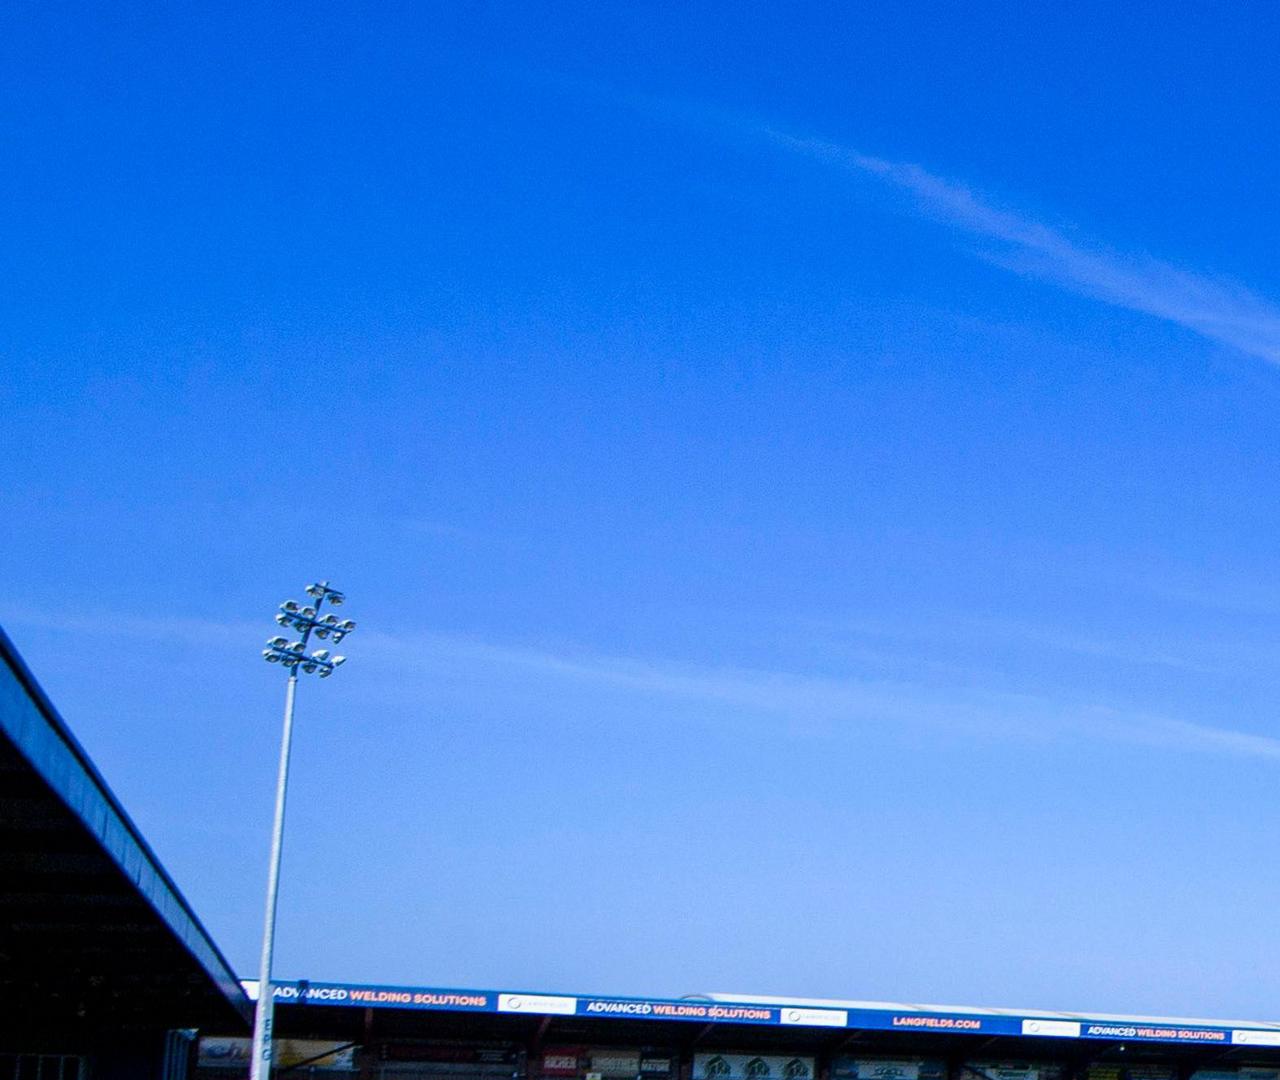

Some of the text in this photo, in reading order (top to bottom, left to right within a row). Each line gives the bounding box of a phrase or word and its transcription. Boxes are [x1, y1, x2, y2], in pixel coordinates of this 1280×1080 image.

[273, 986, 487, 1007] ADVANCED WELDING SOLUTIONS
[587, 1001, 771, 1020] ADVANCED WELDING SOLUTIONS
[893, 1016, 980, 1030] LANGFIELDS.COM
[1088, 1026, 1225, 1041] ADVANCED WELDING SOLUTIONS
